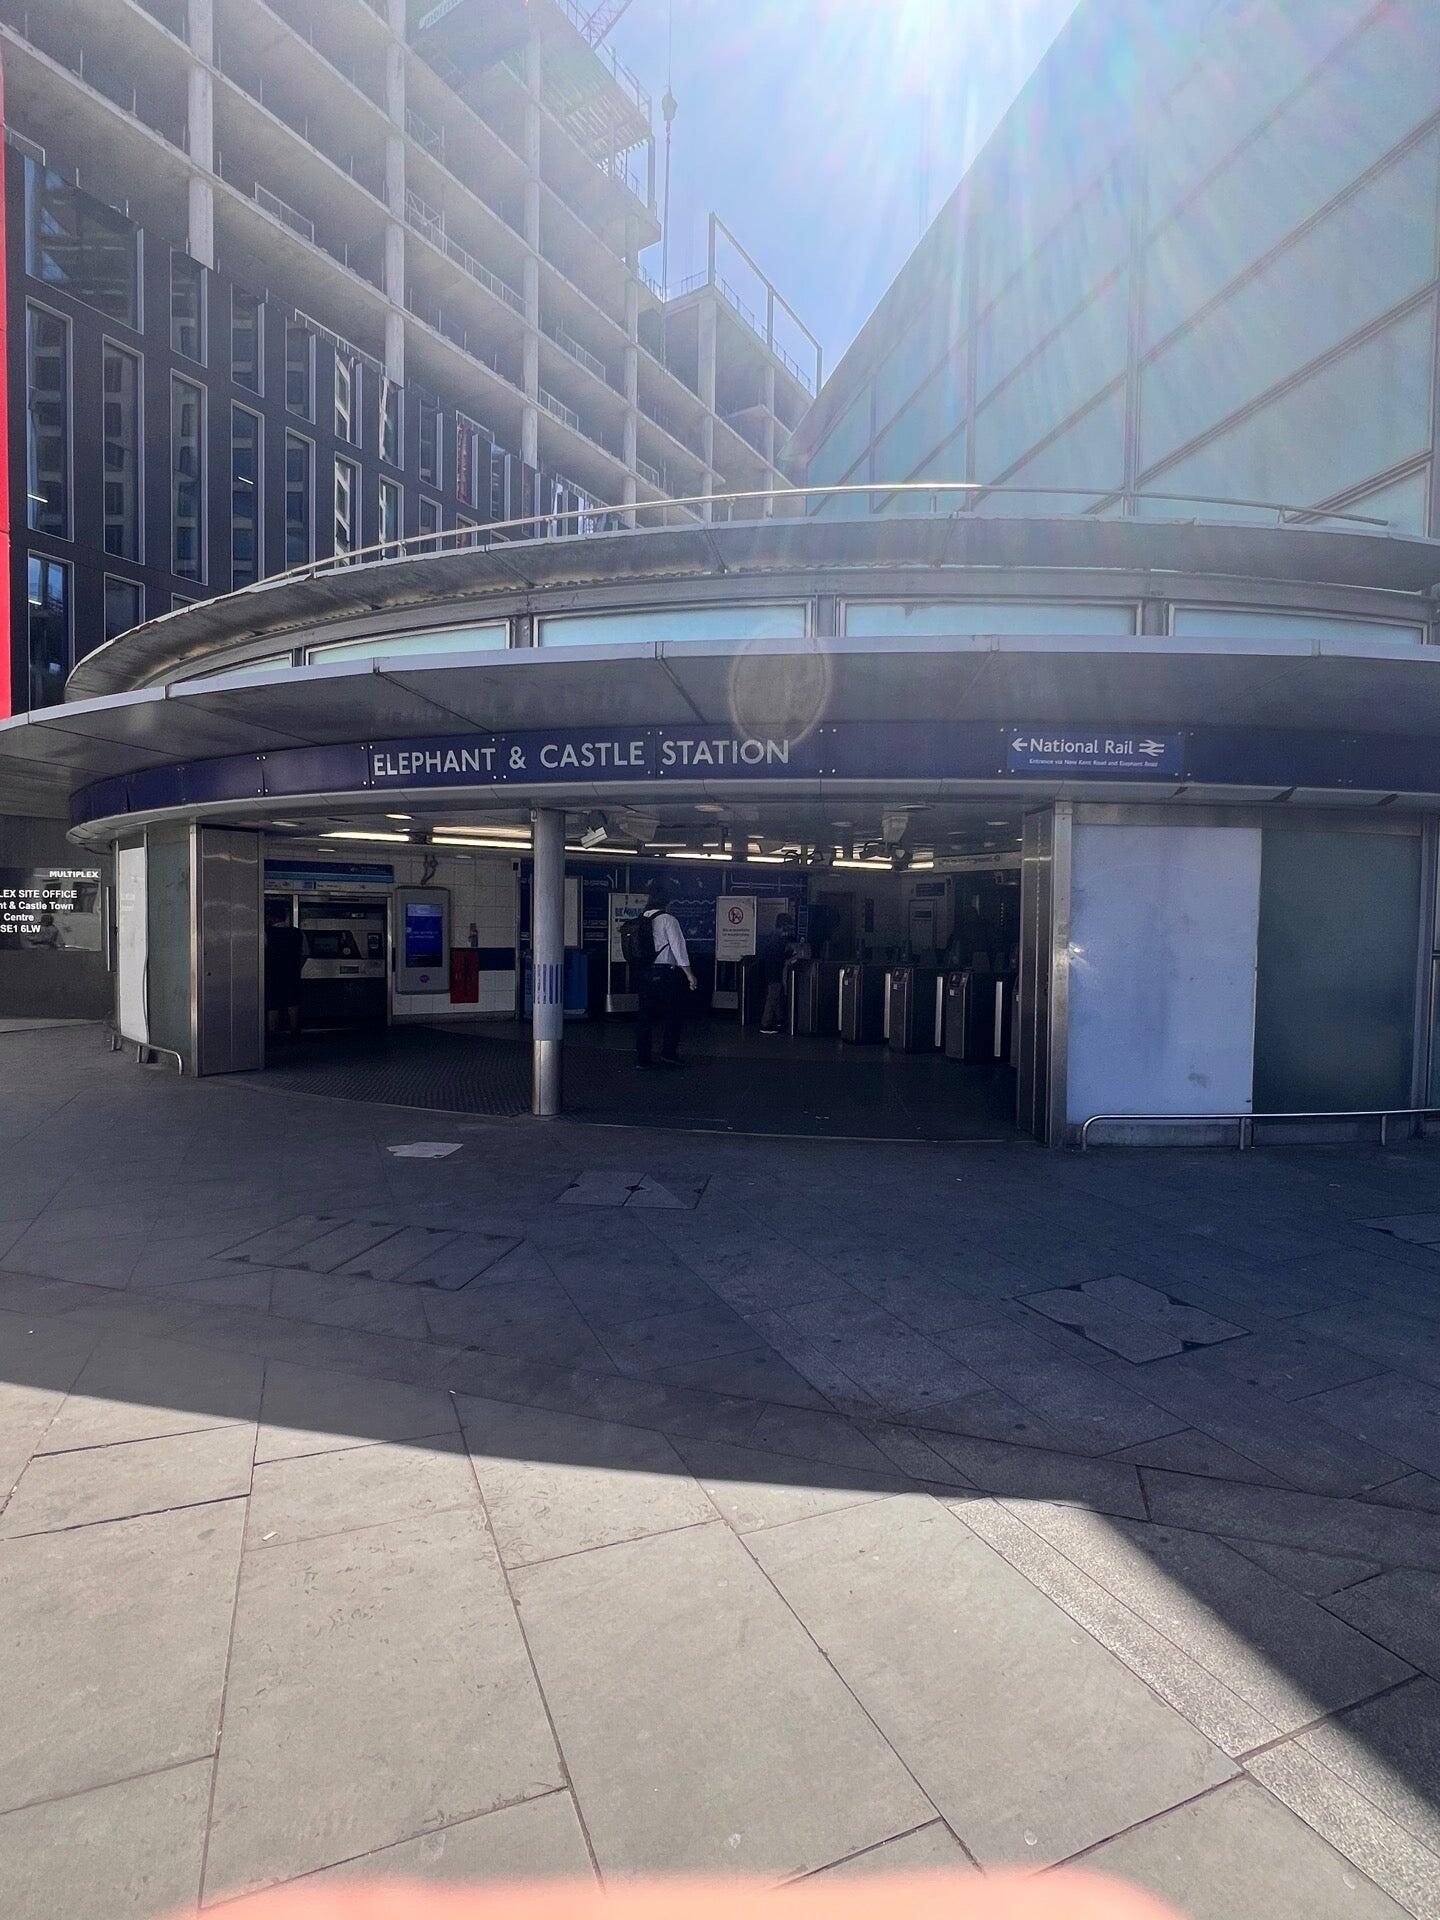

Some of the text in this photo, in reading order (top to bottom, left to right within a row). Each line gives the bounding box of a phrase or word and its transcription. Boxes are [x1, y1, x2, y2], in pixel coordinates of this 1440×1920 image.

[1030, 738, 1133, 754] National Rail
[374, 740, 789, 776] ELEPHANT & CASTLE STATION
[18, 889, 40, 898] SITE
[42, 889, 78, 898] OFFICE
[8, 901, 16, 910] &
[18, 901, 48, 910] Castle
[49, 901, 74, 910] Town
[3, 912, 35, 921] Centre
[0, 924, 41, 933] SE1 6LW
